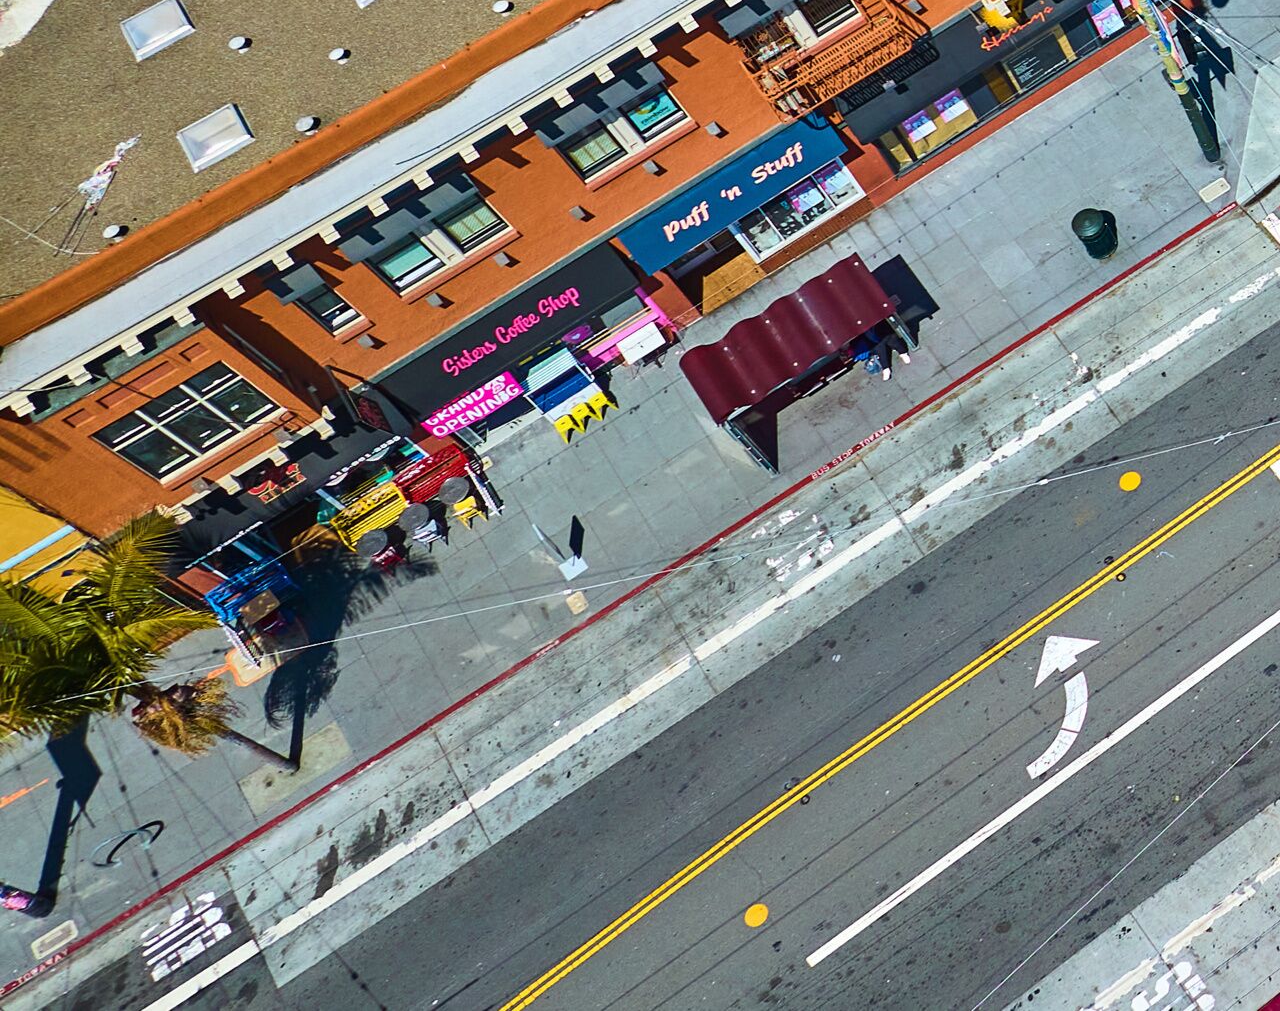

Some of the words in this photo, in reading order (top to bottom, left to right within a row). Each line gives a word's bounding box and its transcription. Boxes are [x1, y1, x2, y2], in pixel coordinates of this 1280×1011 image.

[751, 142, 803, 184] Stuff
[443, 341, 496, 376] Sisters
[496, 314, 540, 344] Coffee
[538, 287, 579, 317] Shop
[425, 387, 485, 426] GRAND
[432, 383, 519, 437] OPENING
[810, 463, 831, 480] BUS
[831, 448, 854, 466] STOP
[16, 948, 69, 983] TOWAWAY
